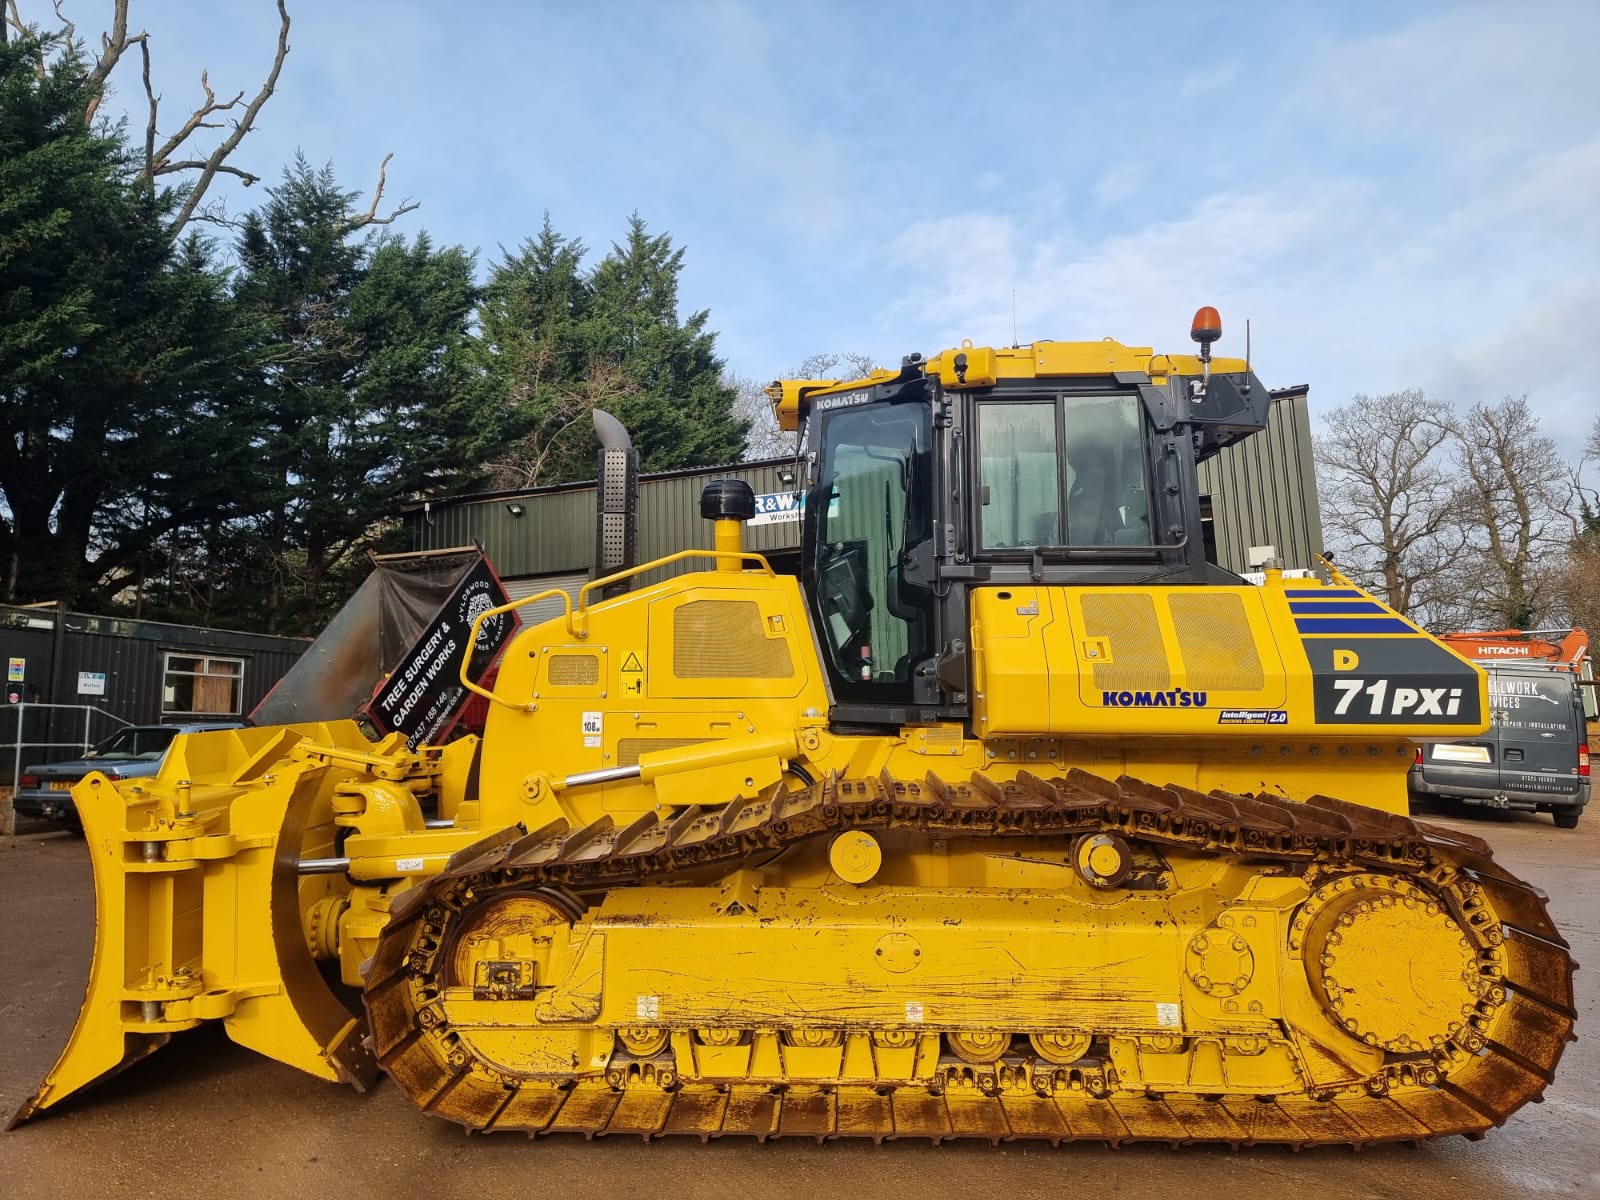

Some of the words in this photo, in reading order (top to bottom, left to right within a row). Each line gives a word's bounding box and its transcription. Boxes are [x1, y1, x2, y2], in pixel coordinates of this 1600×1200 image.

[816, 392, 869, 410] KOMATSU
[1333, 649, 1359, 671] D
[1478, 646, 1529, 655] HITACHI
[381, 679, 409, 712] TREE
[404, 633, 444, 683] SURGERY
[441, 621, 451, 634] &
[392, 679, 430, 728] GARDEN
[425, 639, 457, 680] WORKS
[1102, 687, 1207, 707] KOMATSU
[407, 721, 426, 749] 07437
[425, 706, 437, 723] 188
[1269, 713, 1287, 723] 2.0
